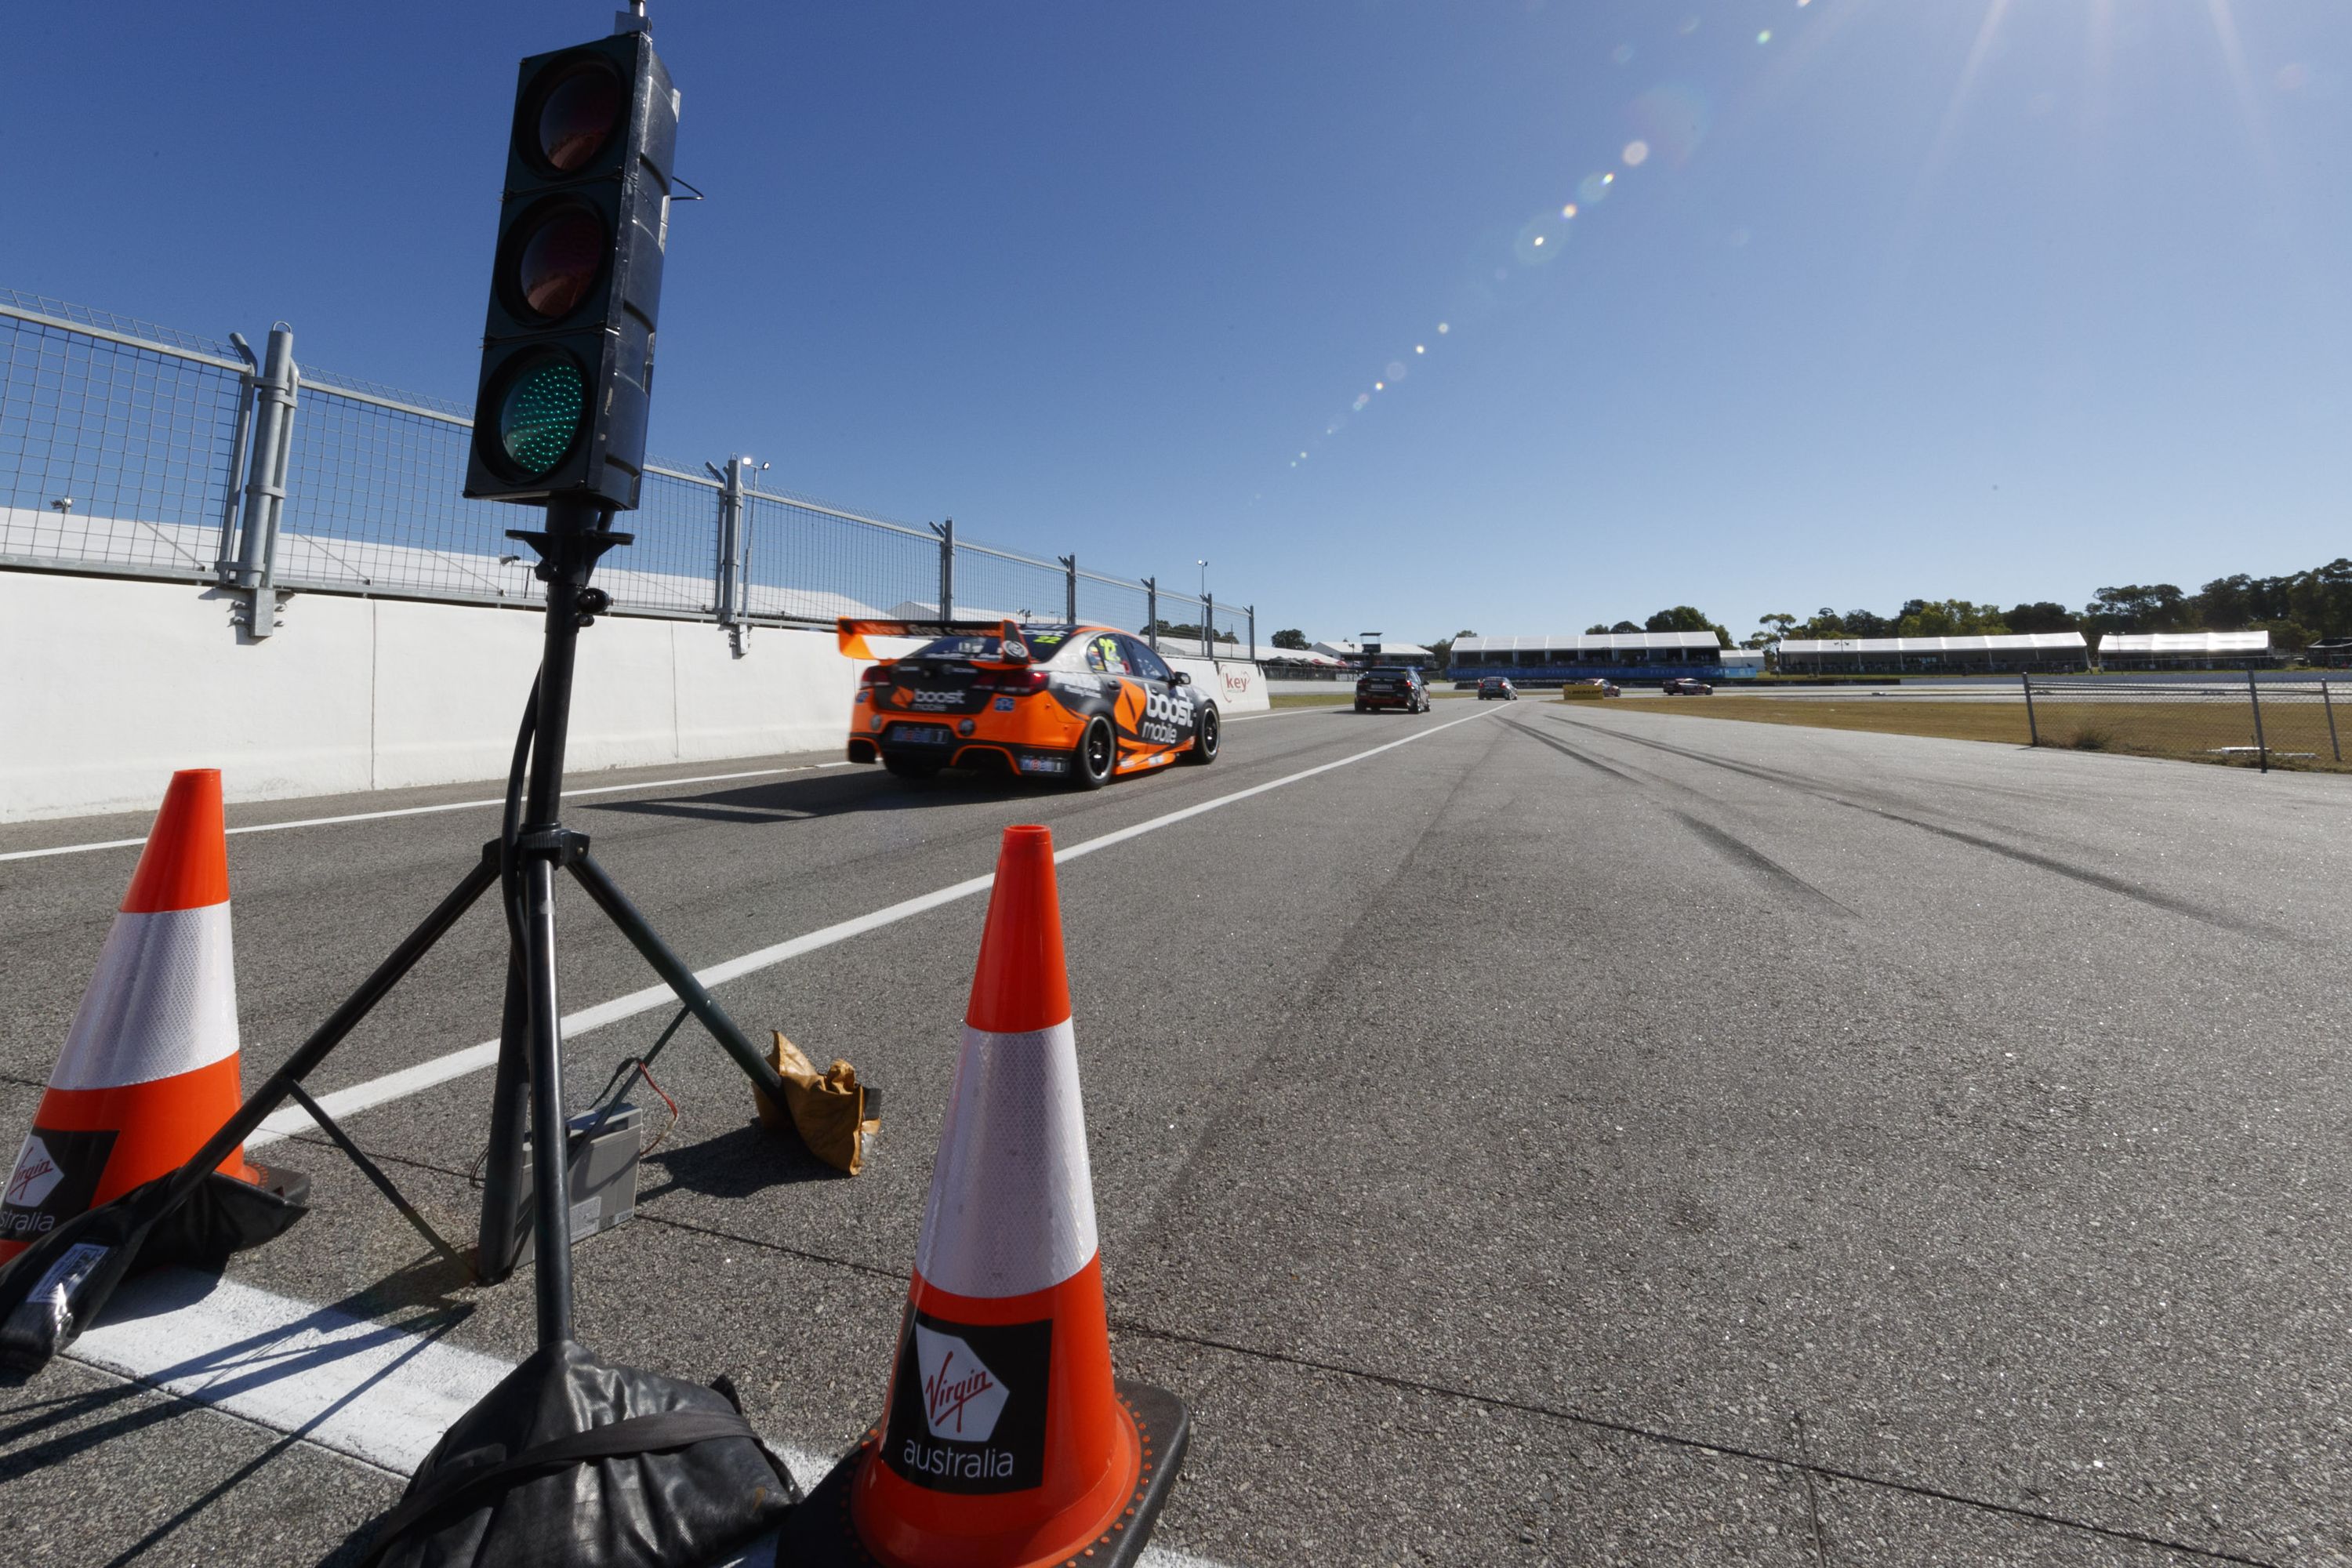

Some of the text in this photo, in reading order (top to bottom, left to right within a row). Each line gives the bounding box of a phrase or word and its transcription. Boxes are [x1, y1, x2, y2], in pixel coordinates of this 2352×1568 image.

[1033, 636, 1062, 644] 22
[1225, 673, 1247, 692] key
[914, 689, 966, 704] boost
[1143, 683, 1194, 728] boost
[1142, 721, 1178, 744] mobile
[0, 1210, 56, 1232] stralia
[925, 1350, 993, 1433] Virgin
[903, 1439, 1014, 1479] australia
